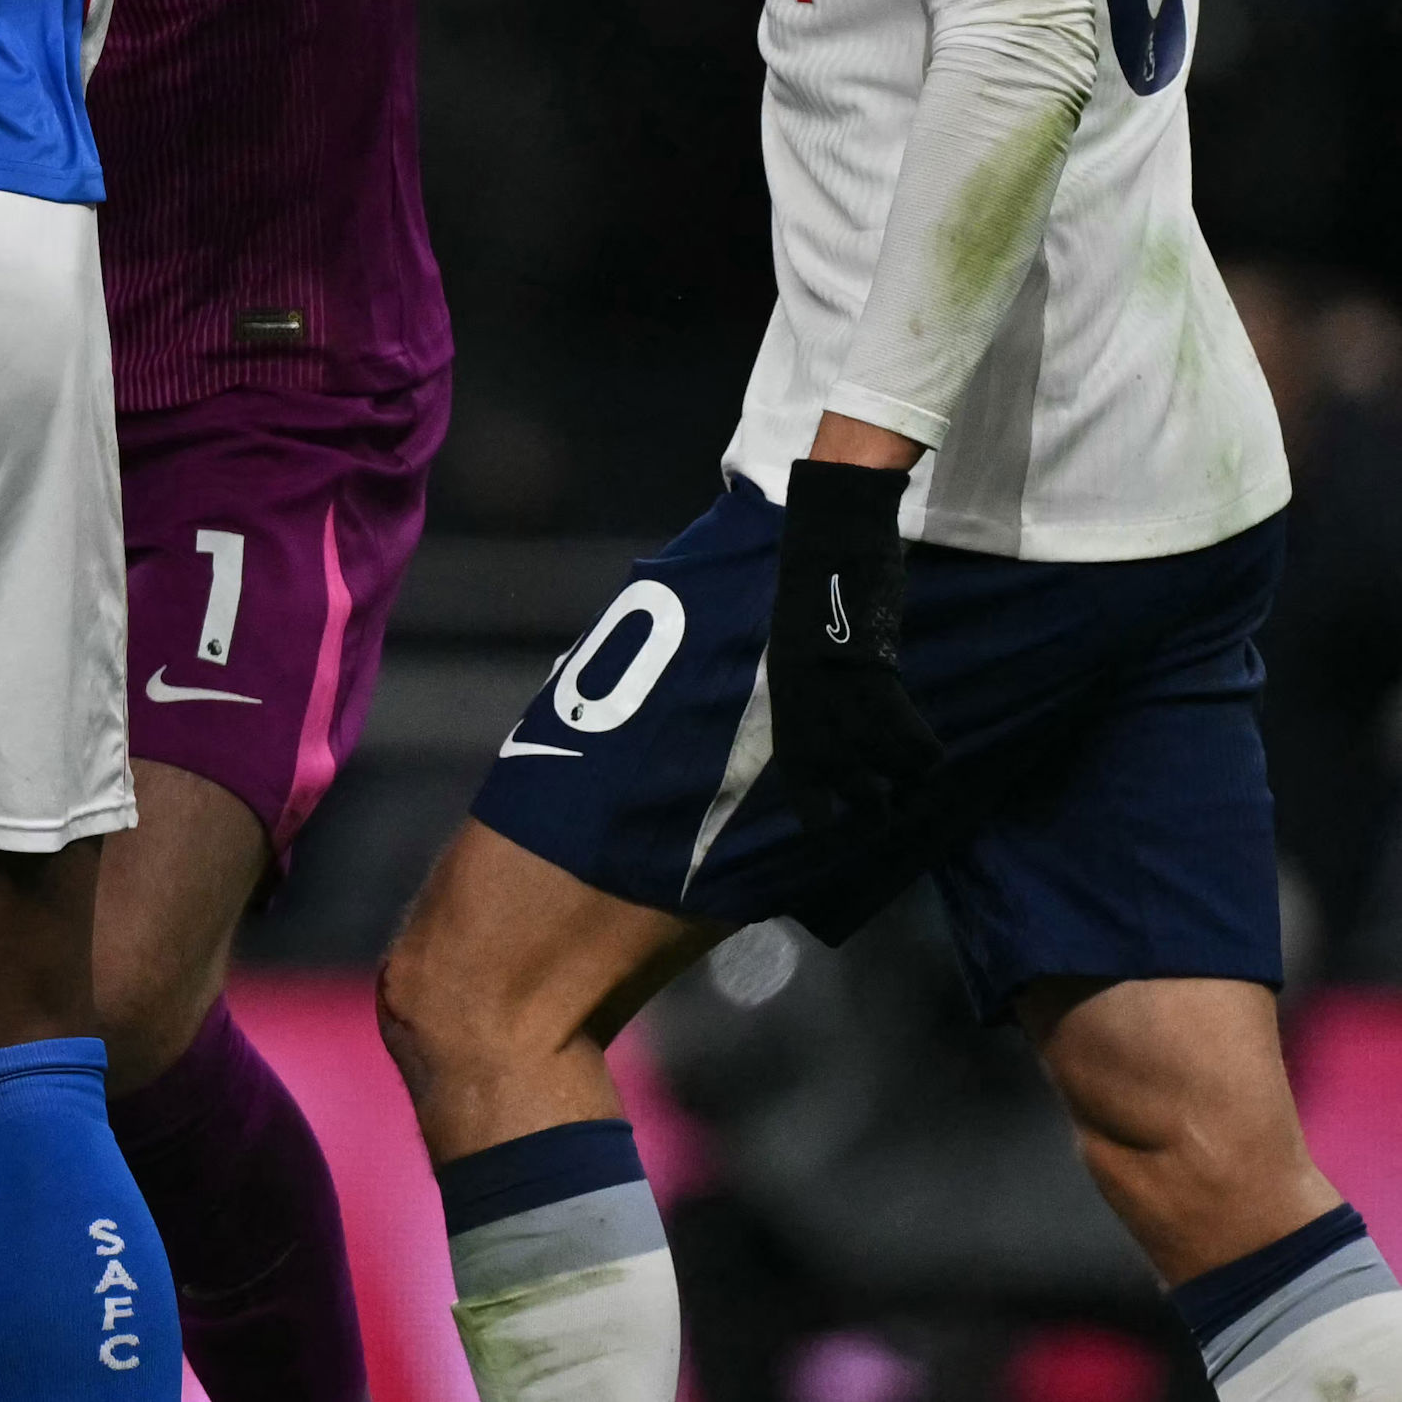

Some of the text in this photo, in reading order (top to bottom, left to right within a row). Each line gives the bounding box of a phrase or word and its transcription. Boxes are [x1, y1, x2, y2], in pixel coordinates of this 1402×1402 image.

[196, 529, 245, 666] 1
[548, 579, 686, 734] 0
[87, 1217, 140, 1371] SAFC
